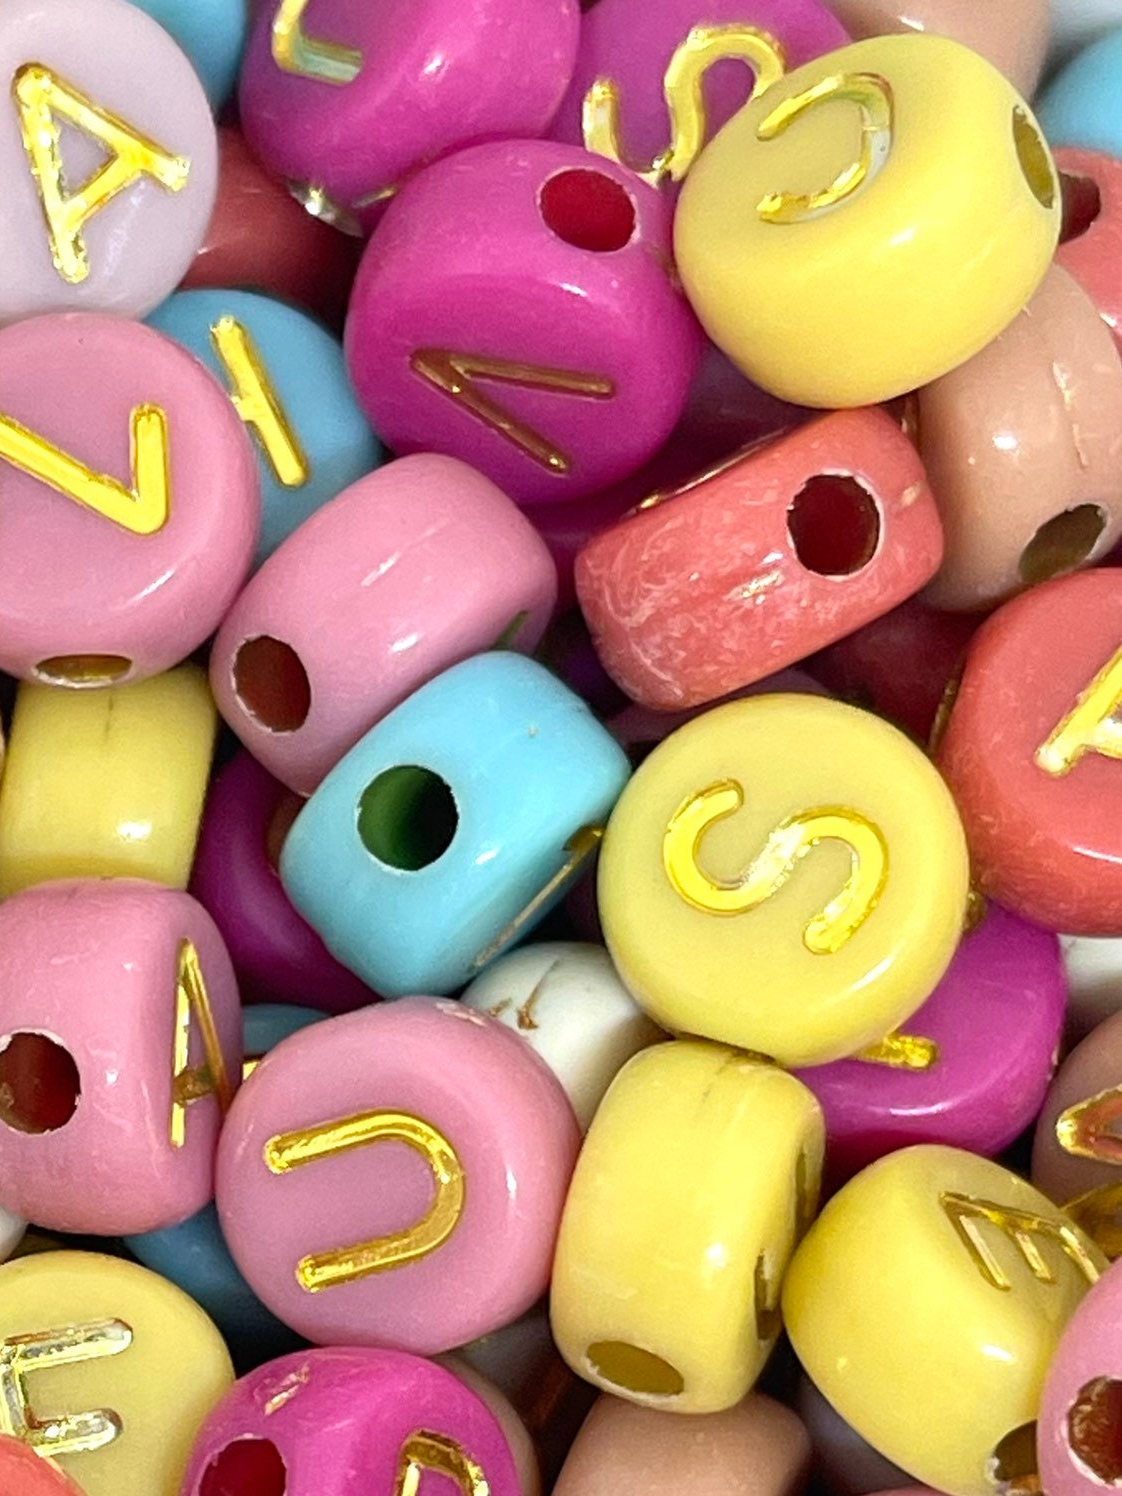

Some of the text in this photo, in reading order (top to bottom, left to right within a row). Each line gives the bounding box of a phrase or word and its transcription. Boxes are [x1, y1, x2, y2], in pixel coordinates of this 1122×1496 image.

[10, 61, 191, 285] A
[662, 778, 890, 956] S
[263, 1109, 466, 1293] U
[938, 1190, 1102, 1292] E
